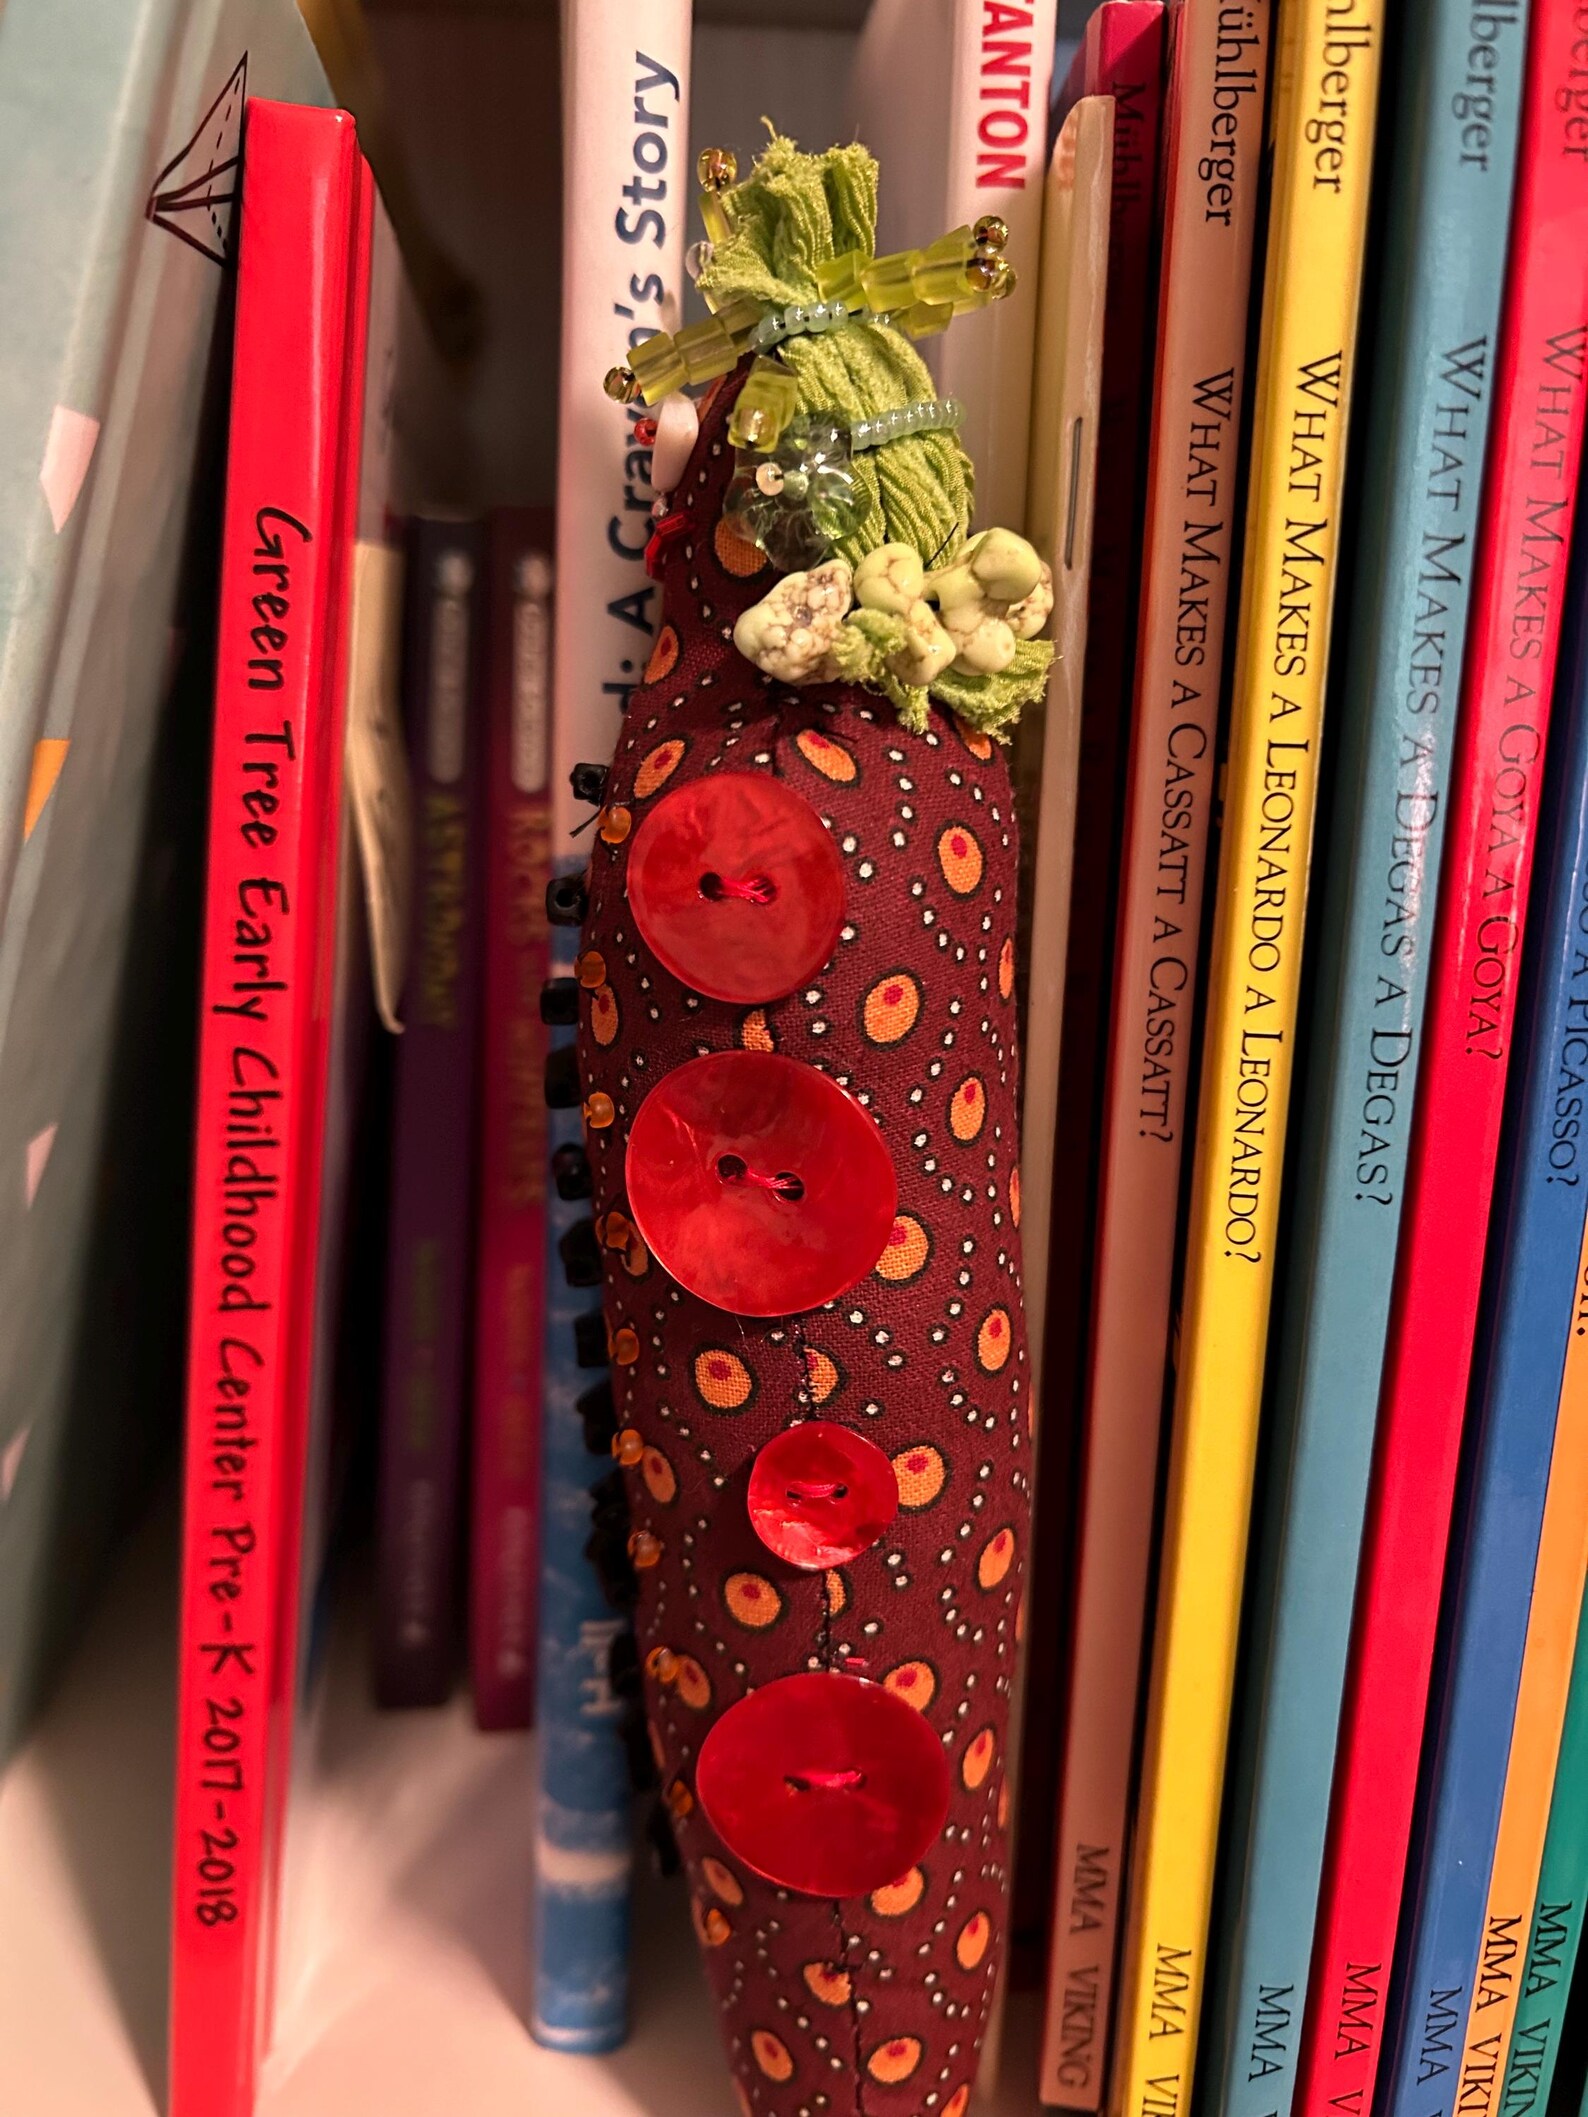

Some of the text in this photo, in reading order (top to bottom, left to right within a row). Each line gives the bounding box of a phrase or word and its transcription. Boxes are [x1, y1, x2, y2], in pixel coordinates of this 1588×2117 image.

[614, 49, 681, 250] Story
[975, 0, 1034, 189] ANTON
[1198, 0, 1261, 227] ühlberger
[606, 586, 655, 637] A
[1463, 325, 1588, 1060] WHAT MAKES A GOYA A GOYA?
[1138, 366, 1235, 1144] WHAT MAKES A CASSATT A CASSATT?
[1223, 350, 1343, 1264] WHAT MAKES A LEONARDO A LEONARDO?
[1352, 334, 1488, 1206] WHAT MAKES A DEGAS A DEGAS?
[195, 506, 313, 1929] Green Tree Early Childhood Center Pre-K 2017-2018
[1056, 1843, 1111, 2090] MMA VIKING
[1148, 1942, 1193, 2041] MMA
[1247, 1983, 1295, 2083] MMA
[1334, 1962, 1382, 2061] MMA
[1416, 1985, 1463, 2087] MMA
[1456, 1913, 1523, 2117] MMA VIKI
[1524, 1901, 1573, 2000] MMA
